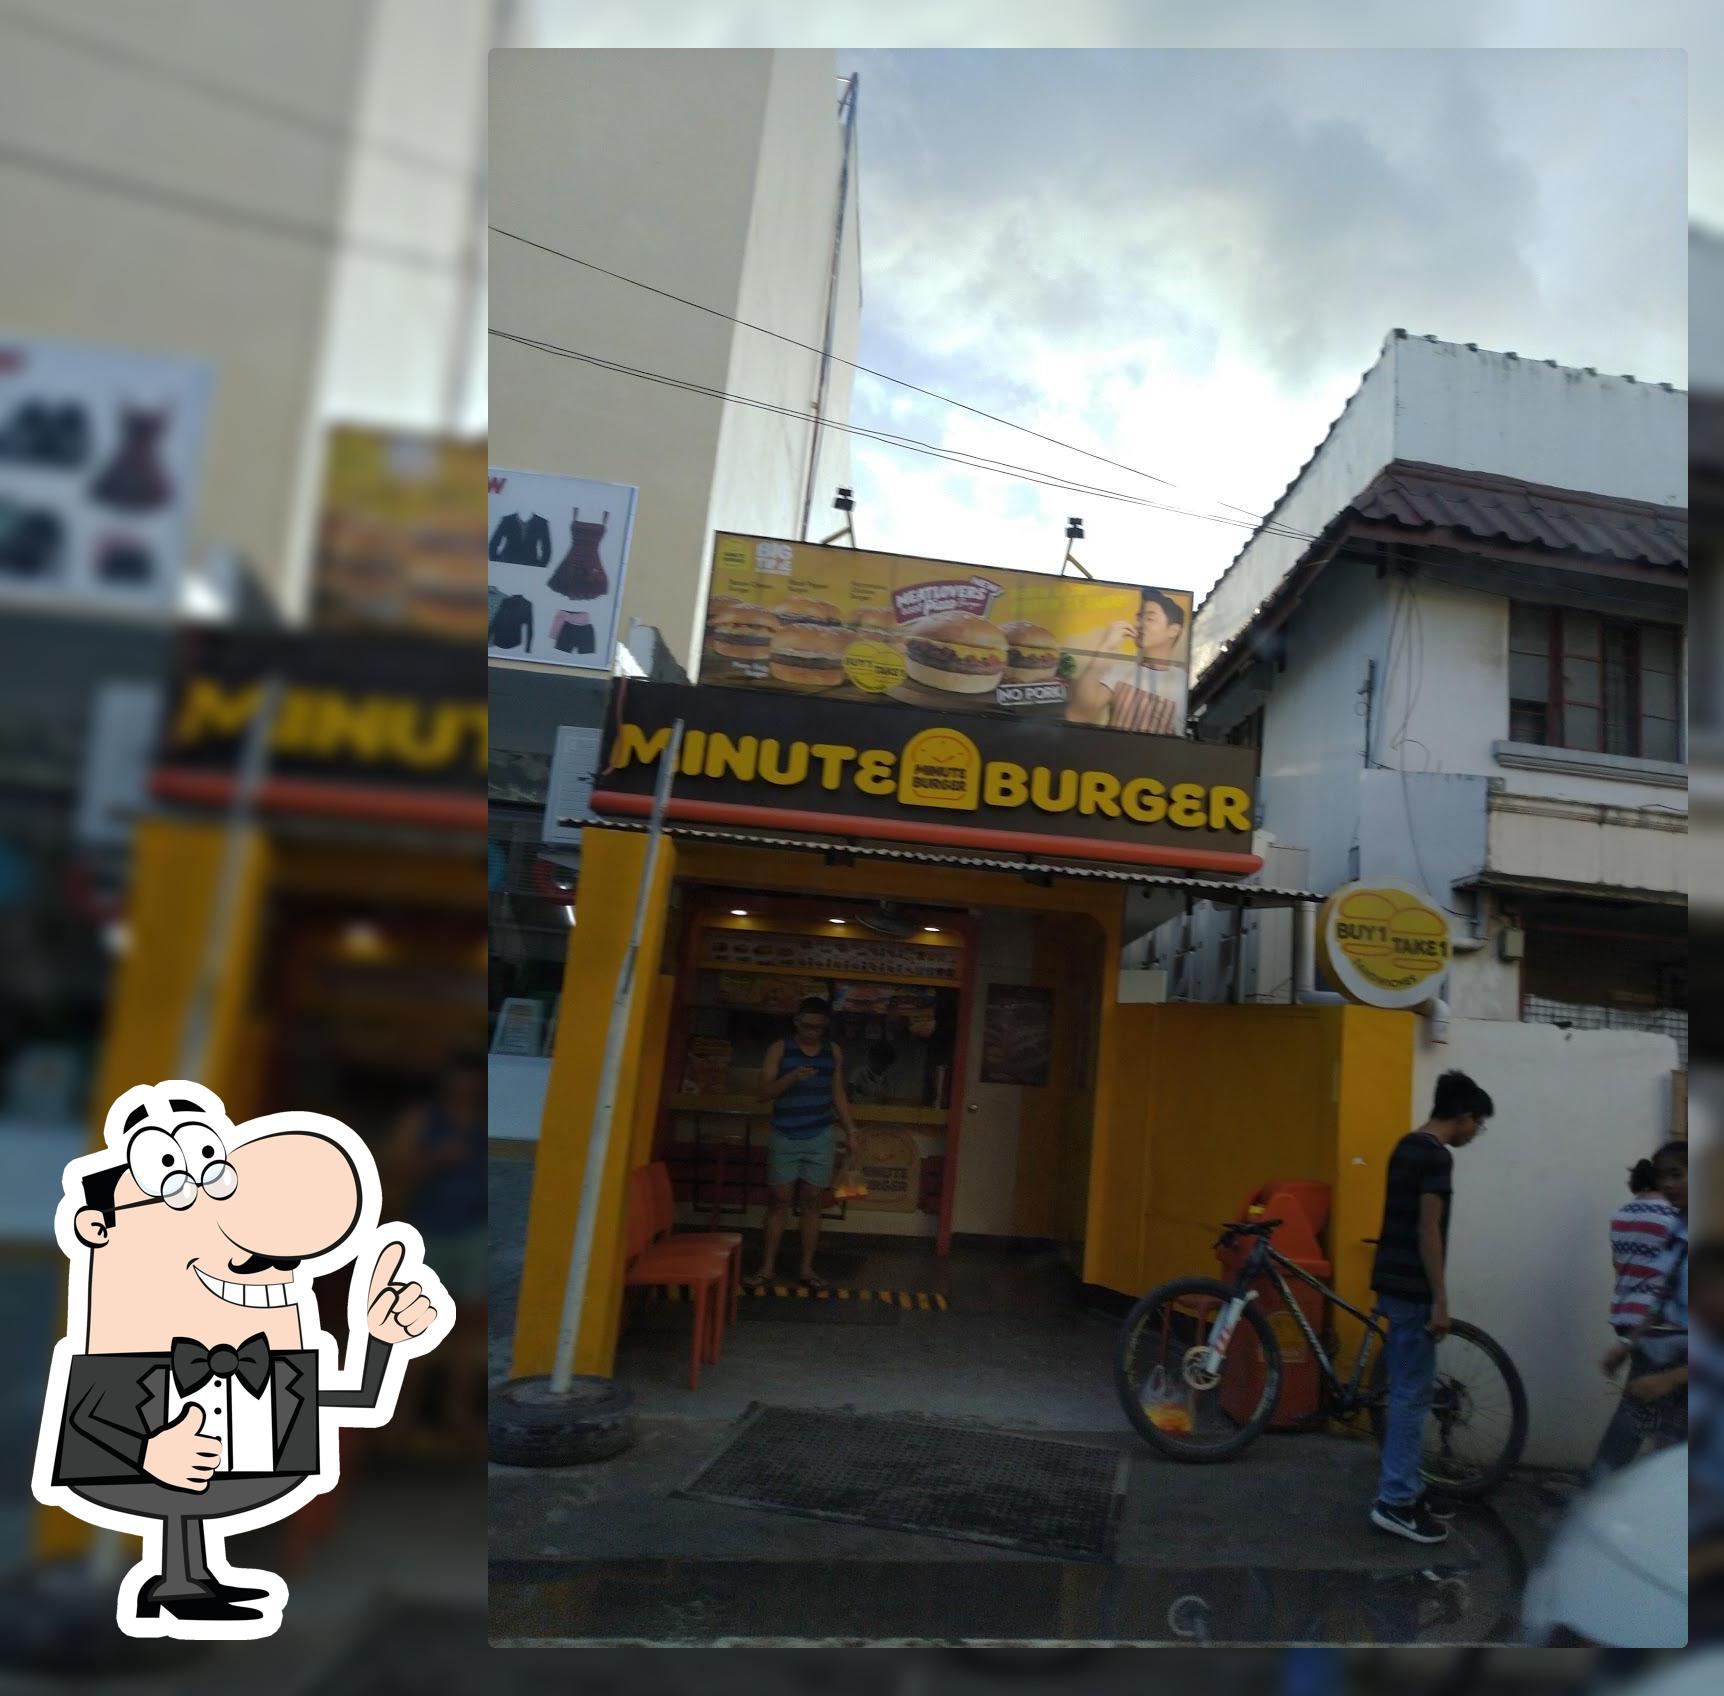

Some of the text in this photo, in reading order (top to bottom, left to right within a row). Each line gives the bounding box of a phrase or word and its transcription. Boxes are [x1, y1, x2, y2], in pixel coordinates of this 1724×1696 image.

[609, 723, 897, 796] MINUTE
[983, 760, 1251, 832] BURGER
[1336, 922, 1376, 940] BUY
[1392, 937, 1436, 956] TAKE
